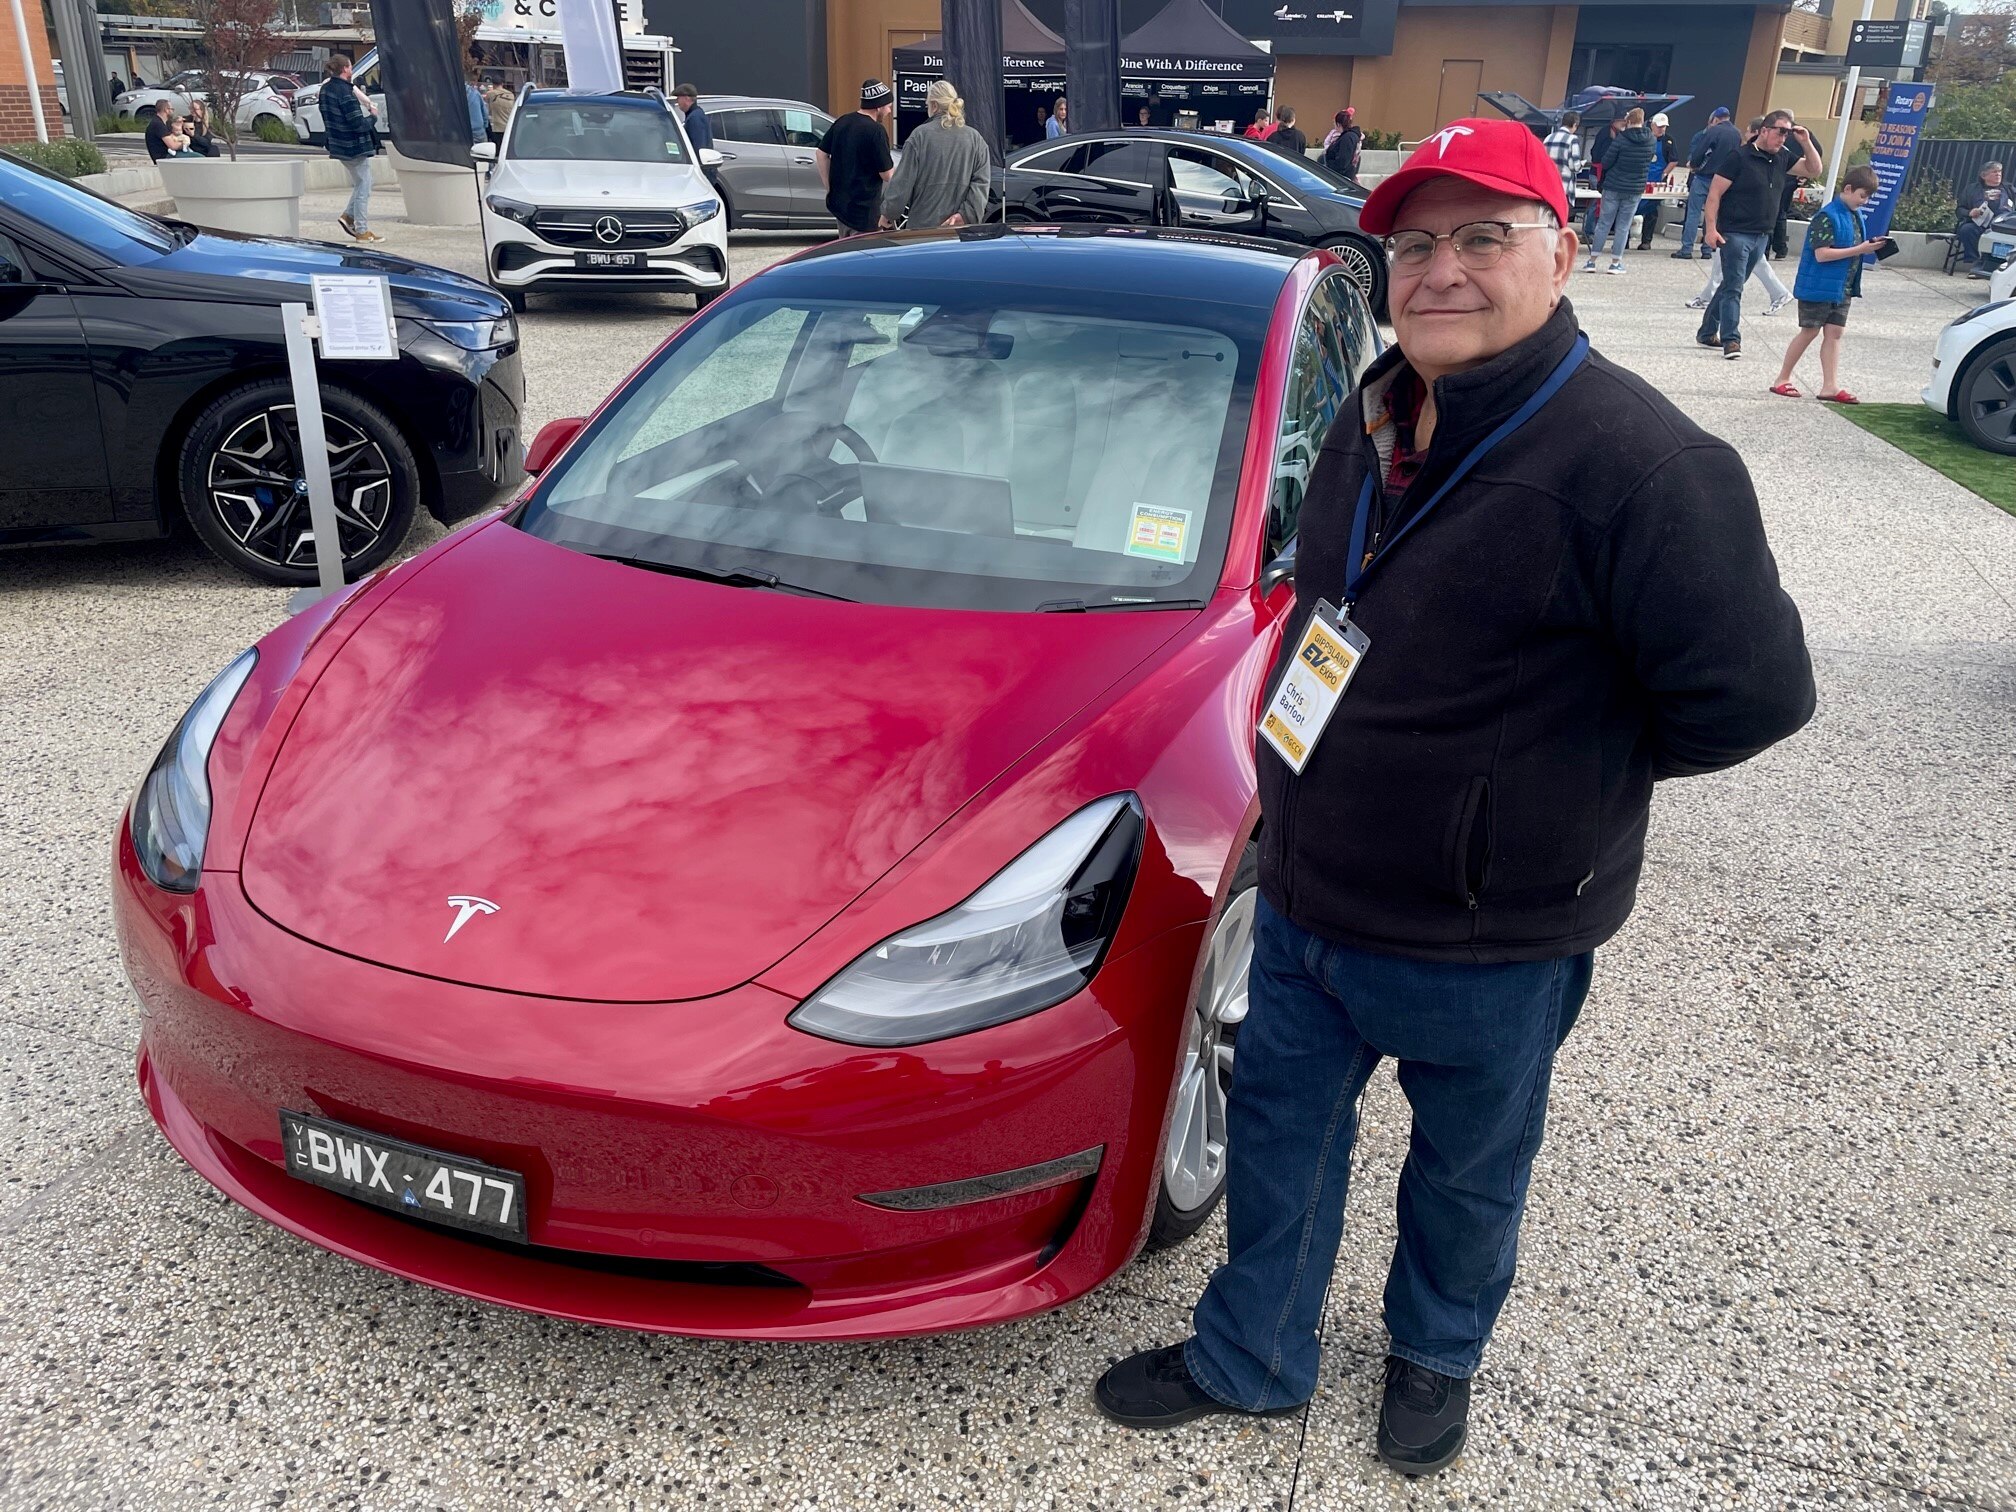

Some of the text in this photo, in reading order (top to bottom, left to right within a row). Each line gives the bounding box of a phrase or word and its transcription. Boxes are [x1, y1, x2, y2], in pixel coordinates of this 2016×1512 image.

[923, 55, 943, 67] Din
[1002, 56, 1045, 68] fference
[1145, 58, 1172, 70] With
[1173, 59, 1183, 71] A
[1185, 60, 1243, 72] Difference
[904, 79, 934, 93] Paell
[1203, 84, 1219, 92] Chips
[1238, 84, 1259, 92] Cannoli
[1895, 95, 1914, 107] Rotary
[1904, 136, 1912, 147] A
[590, 254, 635, 264] BWU 657
[1302, 642, 1329, 667] EV
[1314, 633, 1350, 669] GIPPSLAND
[1319, 667, 1337, 685] EXPO
[1286, 682, 1304, 706] Chris
[1279, 695, 1305, 726] Barfoot
[405, 1196, 416, 1204] EV
[425, 1166, 514, 1224] 477
